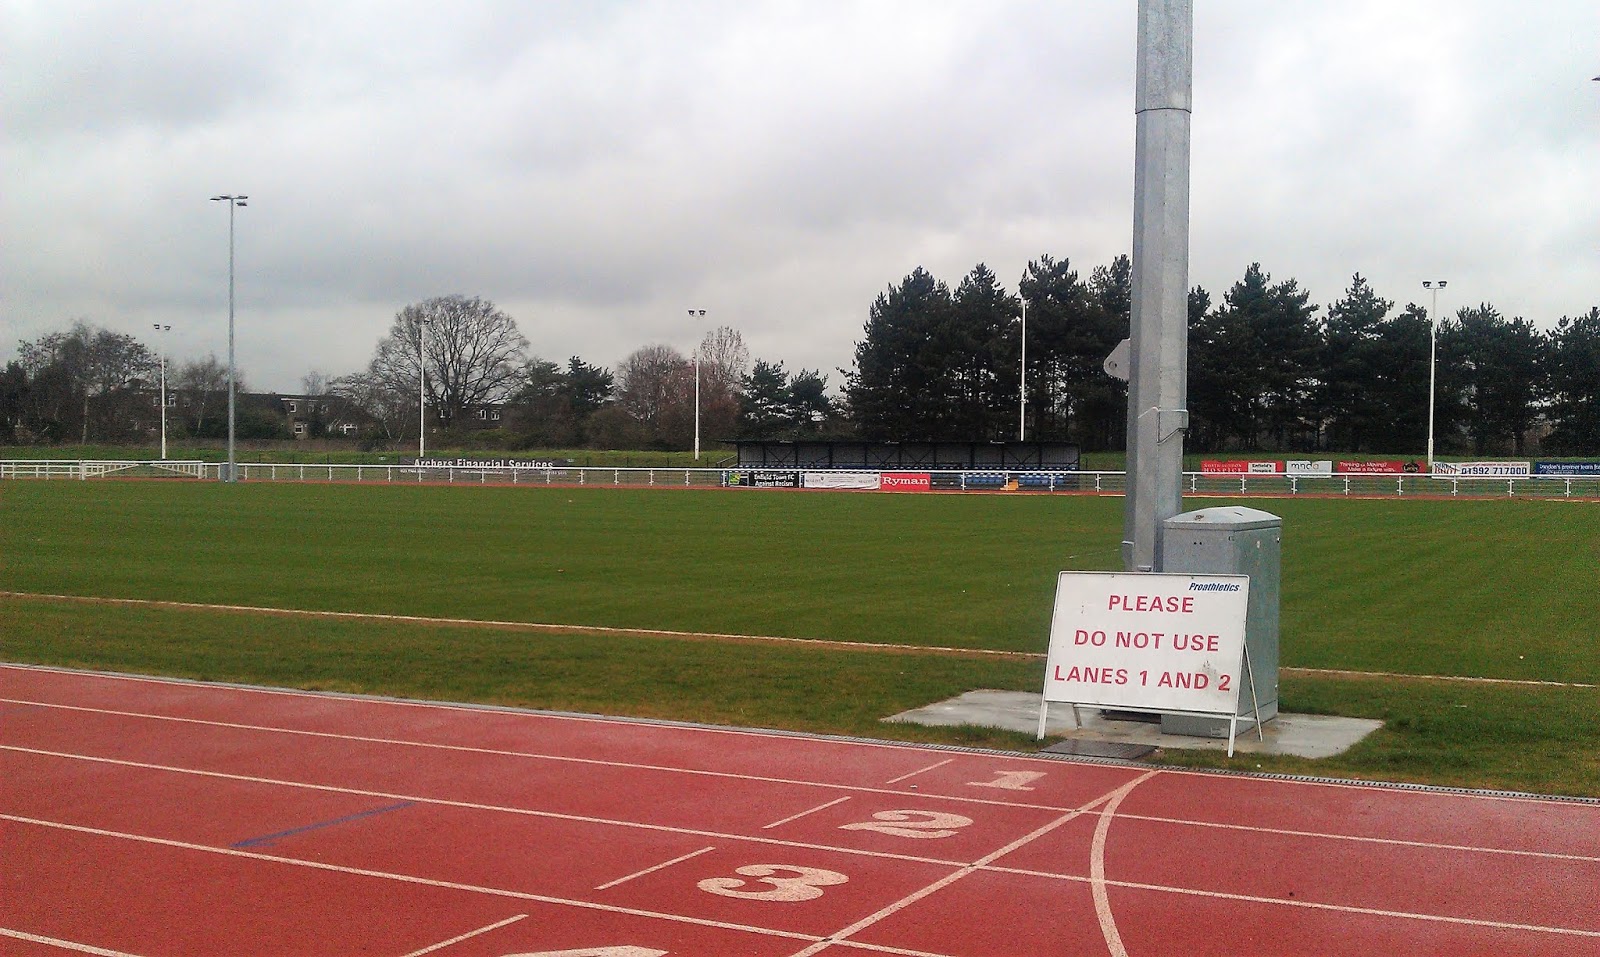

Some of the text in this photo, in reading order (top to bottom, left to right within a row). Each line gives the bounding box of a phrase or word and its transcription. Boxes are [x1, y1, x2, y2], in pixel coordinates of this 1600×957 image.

[414, 458, 554, 470] Archers Financial Services
[1461, 466, 1489, 474] 01992
[882, 476, 929, 486] Ryman
[1188, 582, 1240, 592] Proathletics
[1108, 595, 1194, 613] PLEASE
[1074, 629, 1219, 652] DO NOT USE
[1054, 665, 1231, 691] LANES 1 AND 2
[966, 770, 1048, 791] 1
[838, 809, 974, 839] 2
[696, 863, 850, 902] 3
